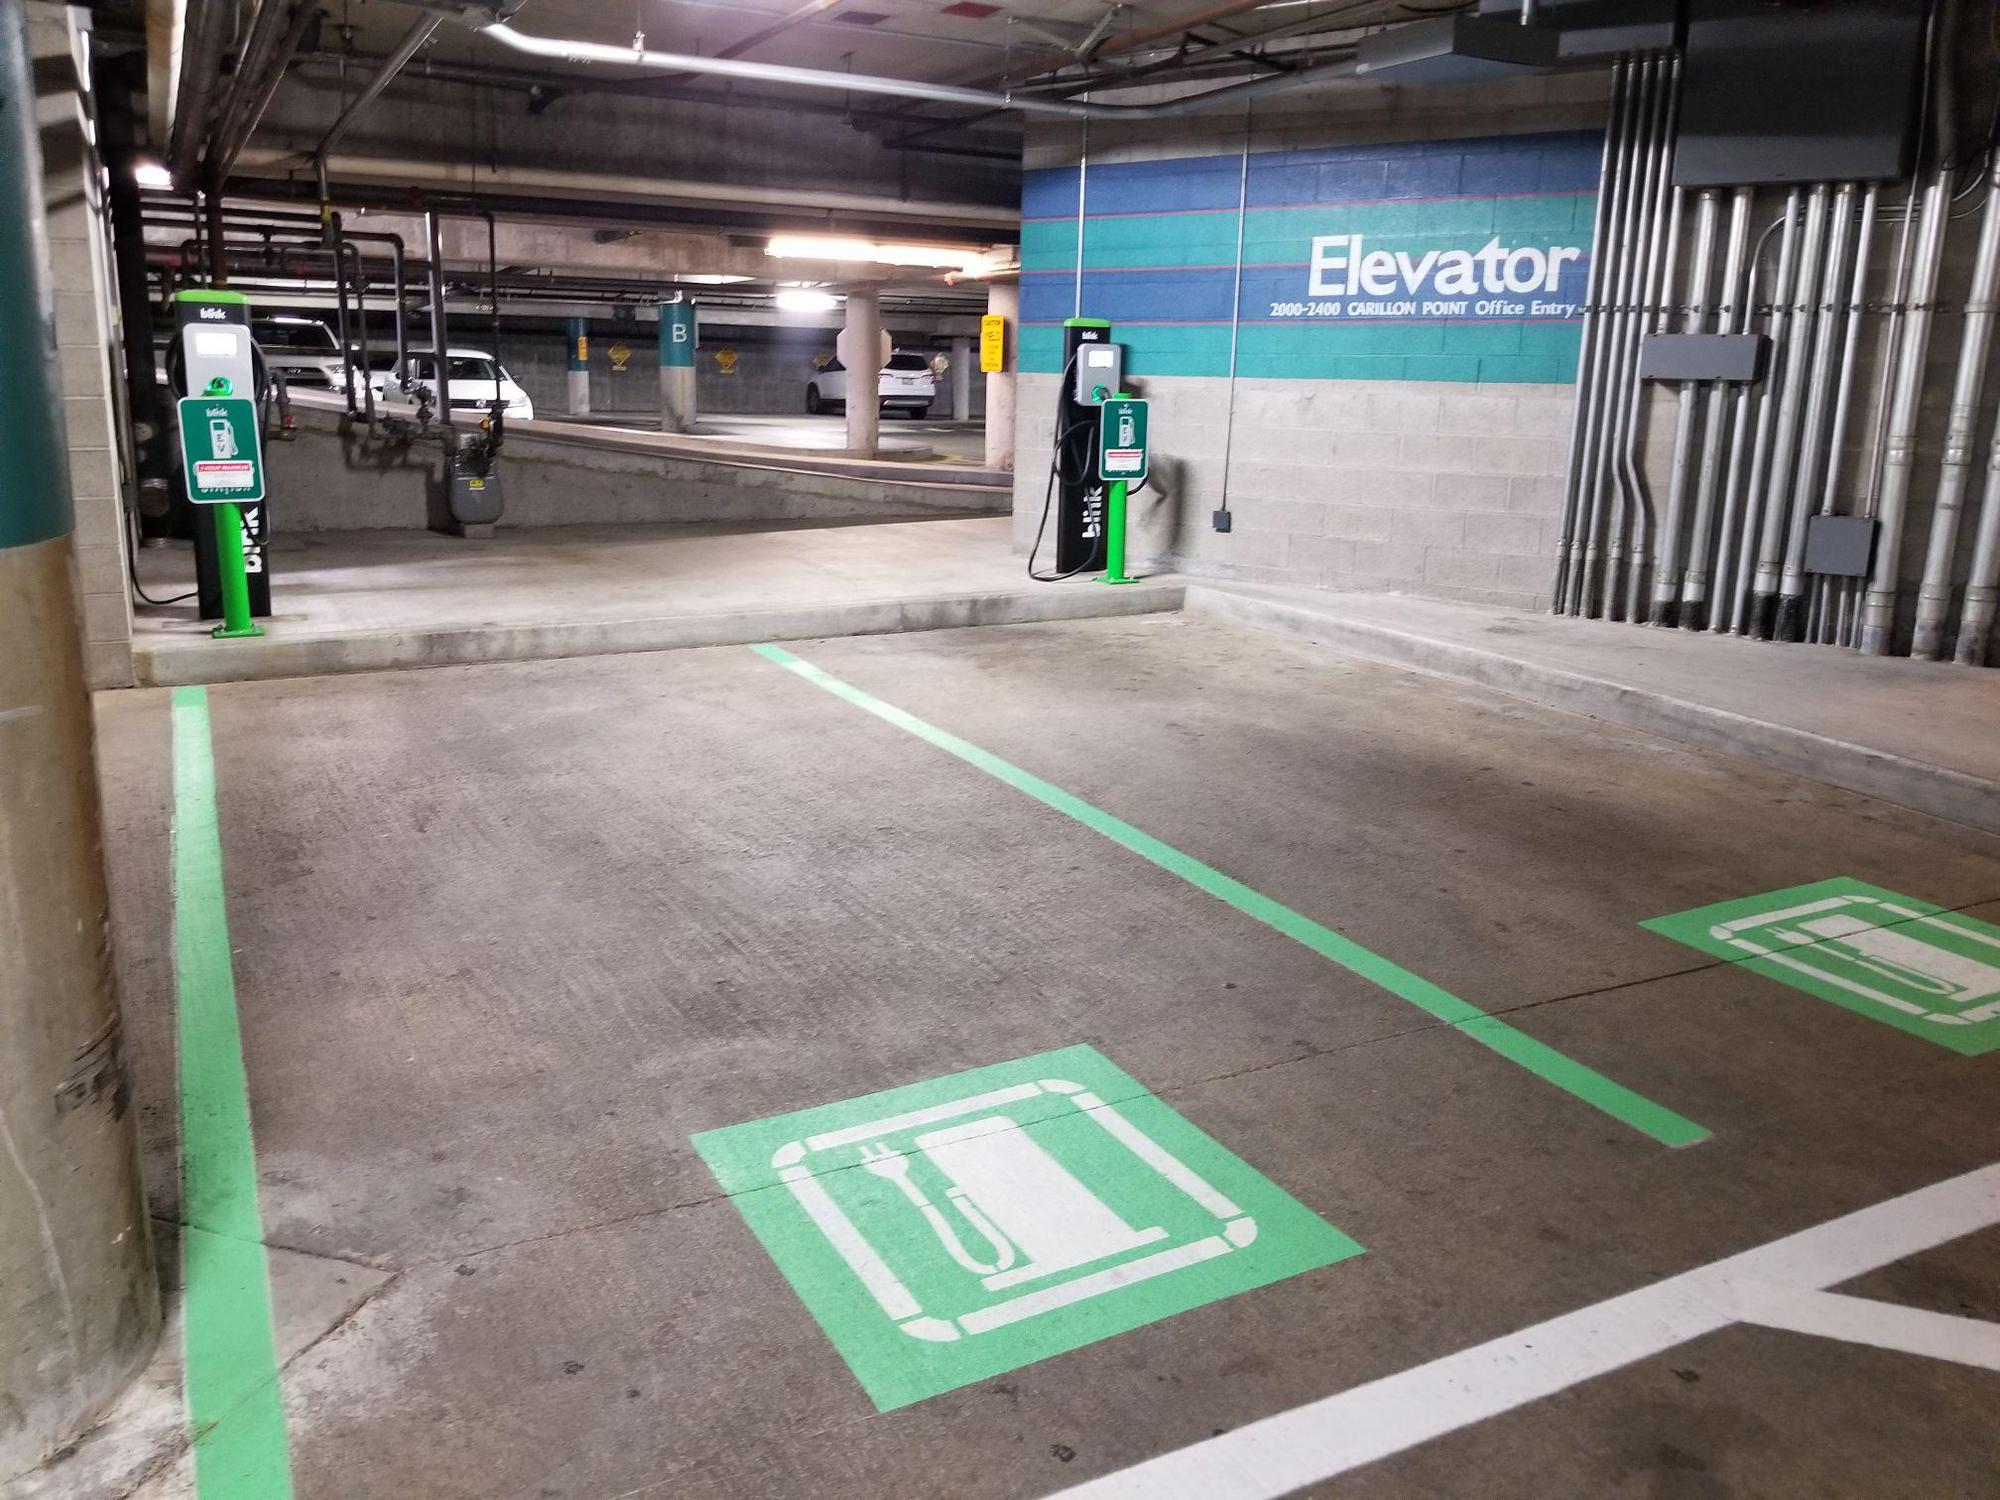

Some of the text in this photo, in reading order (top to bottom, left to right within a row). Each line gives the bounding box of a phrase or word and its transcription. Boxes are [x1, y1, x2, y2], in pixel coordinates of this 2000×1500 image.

[1308, 233, 1581, 297] Elevator
[1269, 300, 1577, 319] 2000-2400 CARILLON POINT Office Entry
[671, 323, 688, 343] B
